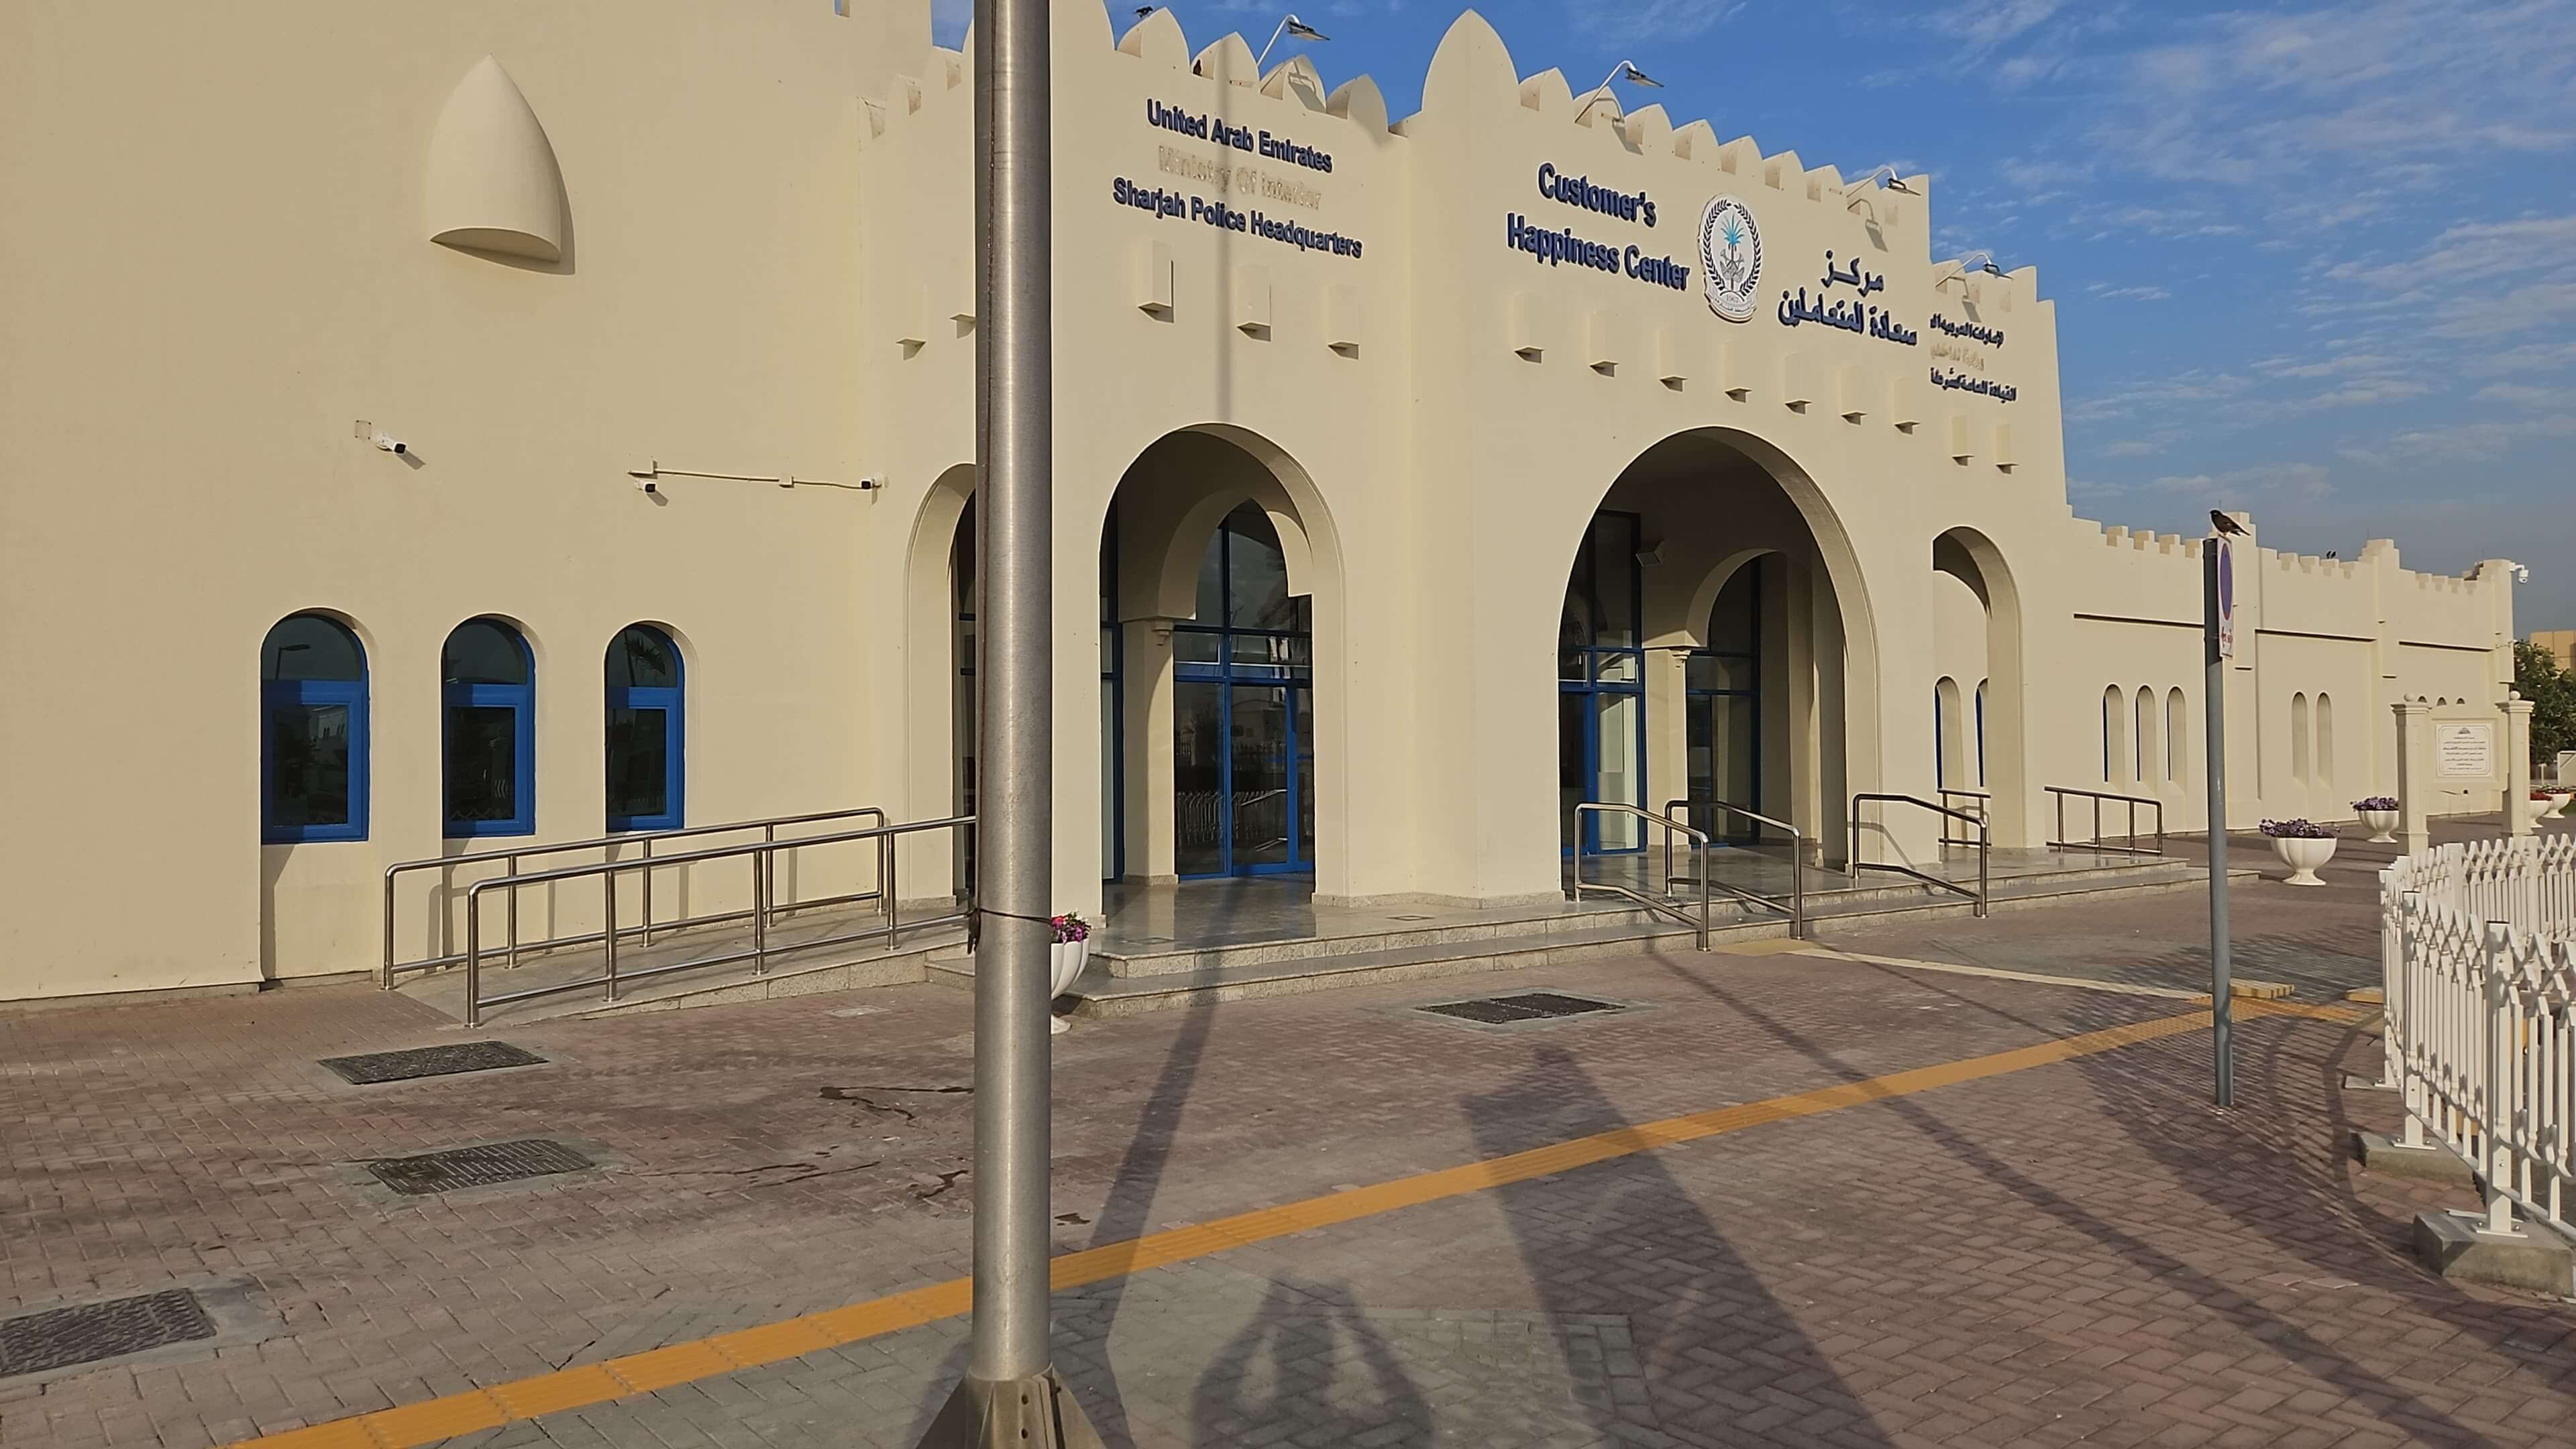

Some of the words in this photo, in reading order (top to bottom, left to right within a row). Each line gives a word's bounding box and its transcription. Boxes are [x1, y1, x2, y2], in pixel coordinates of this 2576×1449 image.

[1147, 98, 1208, 140] United
[1210, 118, 1254, 153] Arab
[1258, 130, 1332, 174] Emirates
[1112, 176, 1186, 219] Sharjah
[1190, 196, 1246, 233] Police
[1250, 210, 1362, 259] Headquarters
[1538, 162, 1657, 228] Customer's
[1507, 213, 1620, 274] Happiness
[1623, 244, 1690, 292] Center
[1820, 250, 1884, 298] مركز
[1778, 286, 1864, 335] المتعاملين
[1868, 305, 1917, 346] سعادة
[1989, 380, 2017, 404] القيادة
